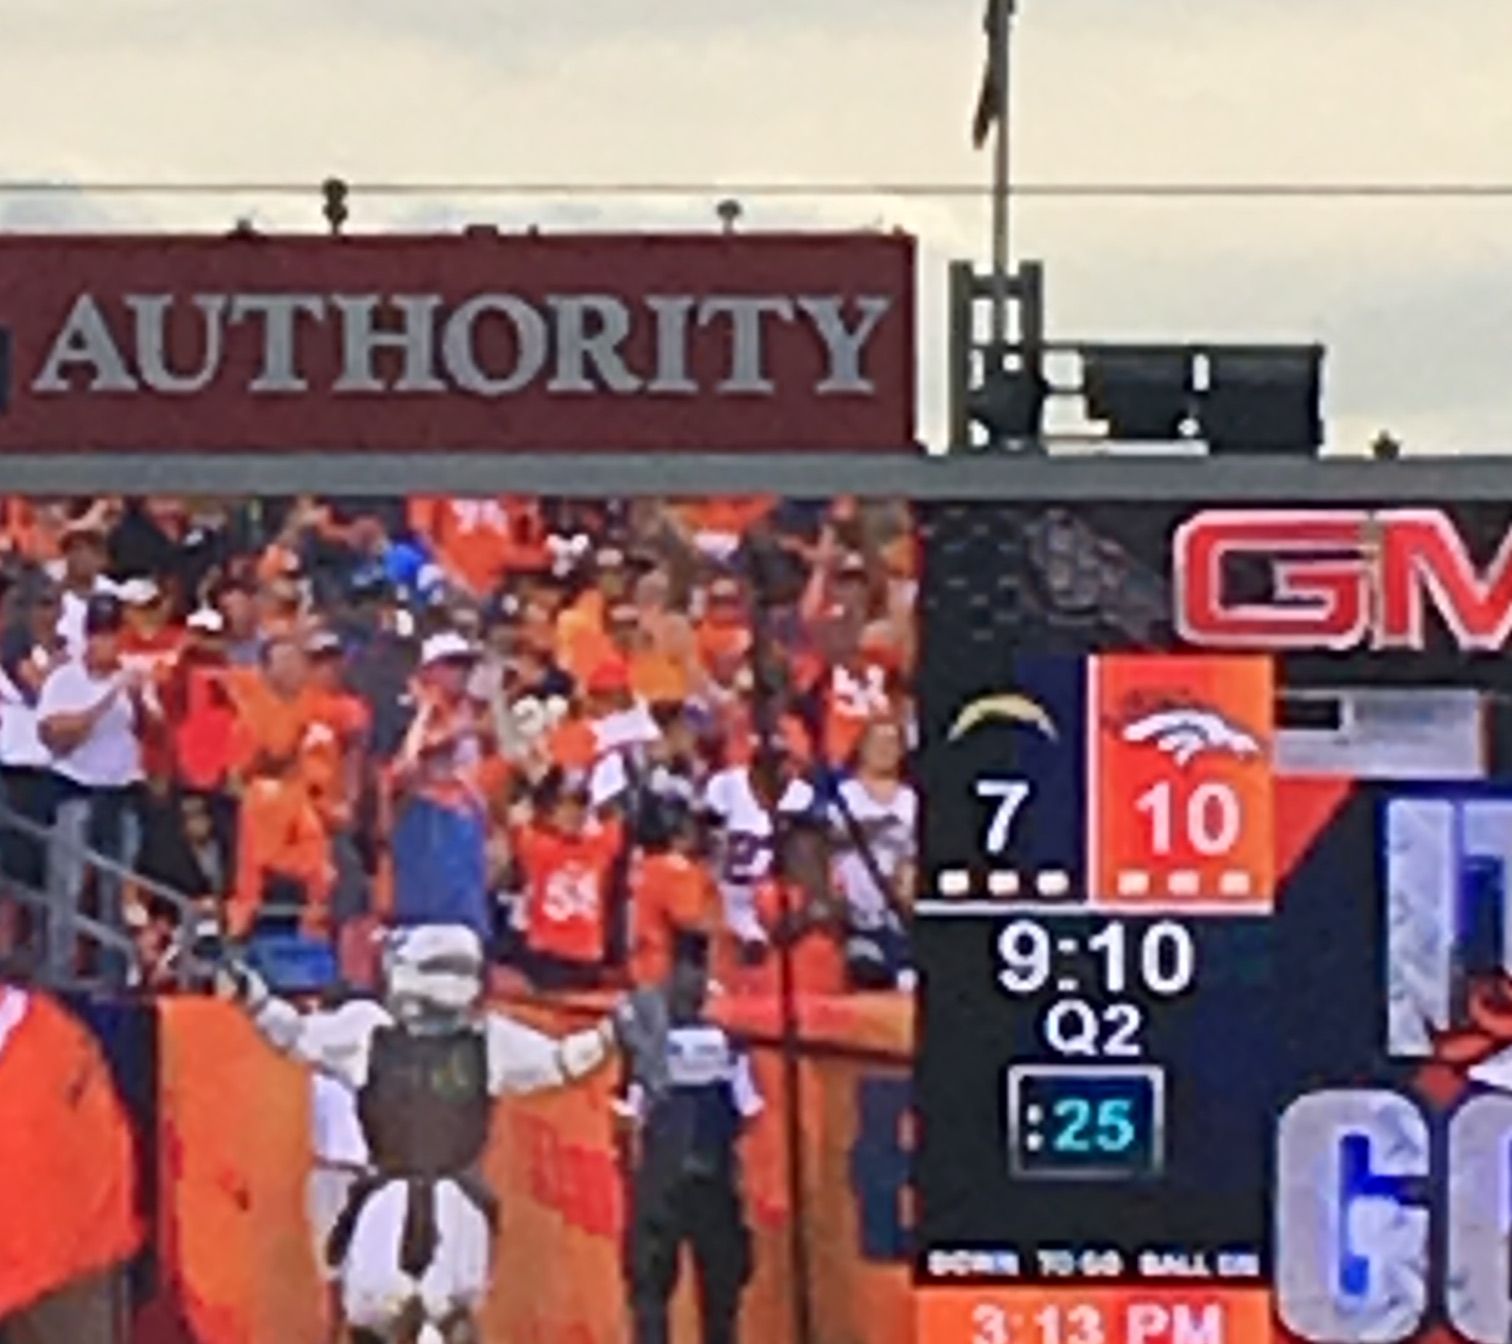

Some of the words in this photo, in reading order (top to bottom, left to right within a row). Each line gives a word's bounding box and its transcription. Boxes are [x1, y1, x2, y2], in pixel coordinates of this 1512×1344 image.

[32, 292, 891, 397] AUTHORITY
[975, 780, 1031, 855] 7
[1134, 780, 1241, 856] 10
[996, 920, 1194, 993] 9:10
[1043, 1001, 1143, 1058] Q2
